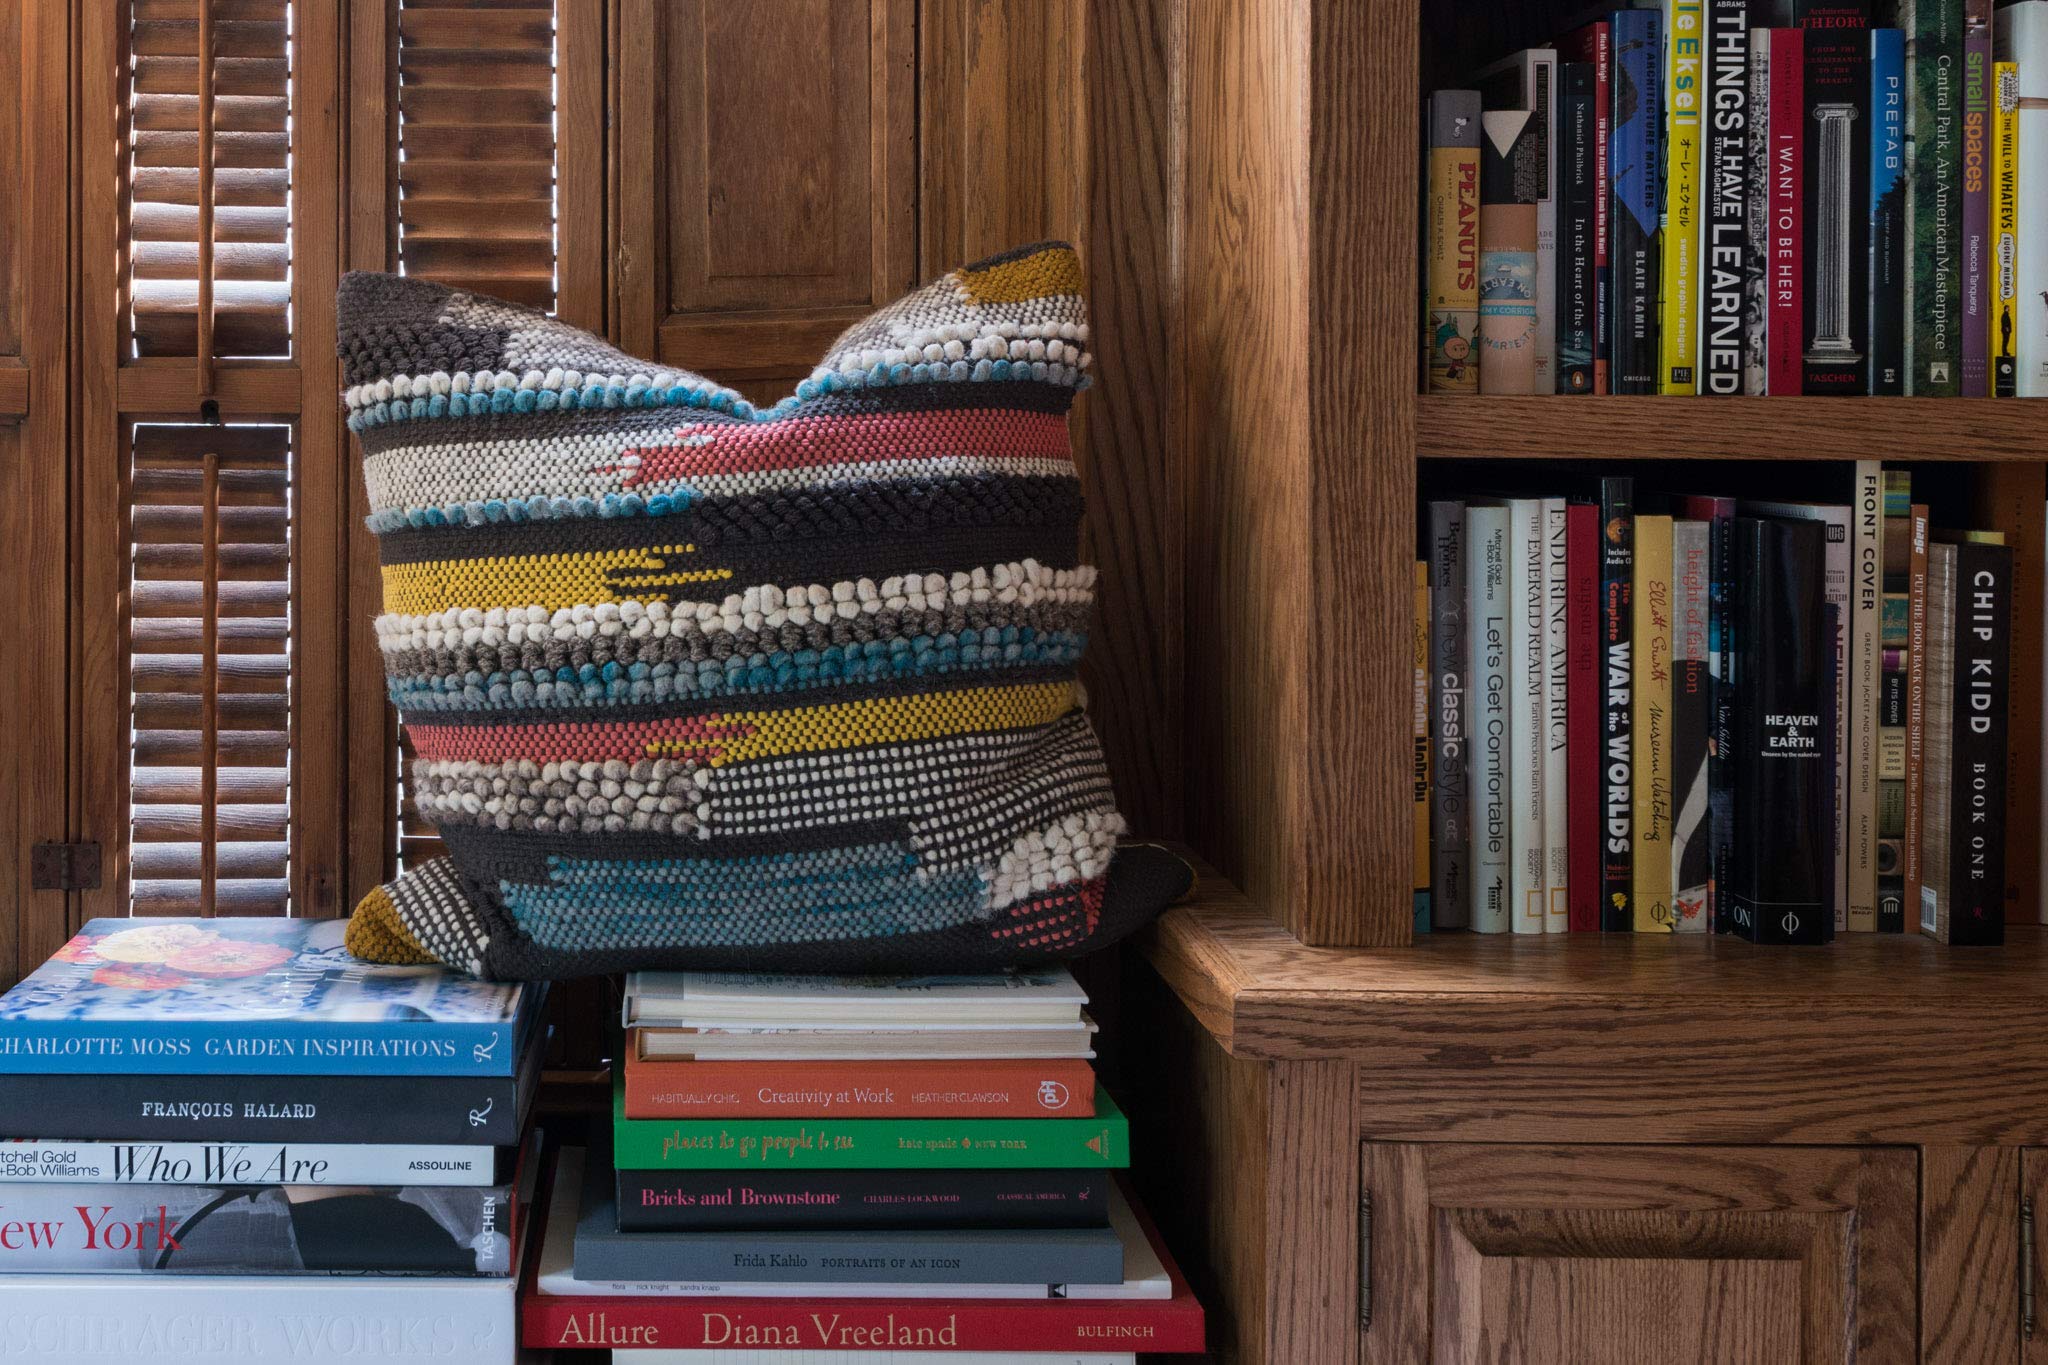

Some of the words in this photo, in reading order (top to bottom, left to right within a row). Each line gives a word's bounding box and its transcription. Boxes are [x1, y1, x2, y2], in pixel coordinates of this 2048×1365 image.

[1646, 21, 1657, 41] WHY
[1801, 17, 1867, 28] THEORY
[1714, 11, 1746, 131] THINGS
[1937, 54, 1951, 109] Central
[1645, 53, 1656, 146] ARCHITECTURE
[1575, 103, 1585, 144] Nathaniel
[1885, 76, 1899, 169] PREFAB
[1936, 112, 1951, 154] Park,
[2003, 118, 2012, 131] THE
[1713, 137, 1722, 166] STEFAN
[1723, 137, 1743, 148] I
[2002, 134, 2013, 156] WILL
[1575, 147, 1585, 185] Philbrick
[1644, 151, 1655, 208] MATTERS
[1779, 147, 1793, 199] WANT
[1936, 158, 1950, 179] An
[2003, 160, 2011, 168] TO
[1712, 168, 1721, 217] SAGMEISTER
[1721, 156, 1743, 217] HAVE
[2000, 170, 2014, 229] WHATEVS
[1457, 162, 1476, 292] PEANUTS
[1574, 218, 1586, 231] In
[1778, 207, 1793, 230] TO
[1936, 184, 1950, 253] American
[1574, 233, 1586, 253] the
[1679, 238, 1689, 277] swedish
[1778, 238, 1792, 258] BE
[1969, 235, 1980, 272] Rebecca
[2003, 236, 2011, 263] EUGENE
[1574, 256, 1586, 290] Heart
[1634, 251, 1645, 289] BLAIR
[1778, 266, 1792, 307] HER!
[2003, 266, 2011, 297] MIRMAN
[1574, 293, 1585, 304] of
[1677, 279, 1689, 316] graphic
[1709, 224, 1742, 394] LEARNED
[1932, 257, 1950, 350] Masterpiece
[1968, 274, 1979, 316] Tanqueray
[1574, 308, 1585, 327] the
[1634, 296, 1645, 339] KAMIN
[1574, 330, 1585, 350] Sea
[1677, 317, 1688, 359] designer
[1808, 374, 1857, 383] TASCHEN
[1530, 515, 1539, 534] THE
[1863, 475, 1876, 539] FRONT
[1449, 521, 1460, 566] Better
[1486, 539, 1495, 563] +Bob
[1494, 528, 1503, 562] Mitchell
[1915, 517, 1927, 555] Image
[1438, 537, 1453, 588] Homes
[1494, 564, 1503, 586] Gold
[1550, 509, 1566, 635] ENDURING
[1683, 550, 1703, 600] height
[1862, 548, 1875, 610] COVER
[1486, 564, 1495, 600] Williams
[1527, 539, 1541, 629] EMERALD
[1622, 583, 1632, 605] The
[1606, 582, 1620, 641] Complete
[1649, 580, 1667, 632] Elliott
[1687, 608, 1703, 629] of
[1973, 570, 1995, 642] CHIP
[1486, 617, 1504, 668] Let's
[1528, 634, 1541, 696] REALM
[1608, 641, 1631, 706] WAR
[1685, 631, 1703, 694] fashion
[1487, 676, 1504, 714] Get
[1550, 644, 1567, 752] AMERICA
[1862, 684, 1870, 713] JACKET
[1970, 659, 1992, 734] KIDD
[1608, 712, 1619, 732] the
[1621, 713, 1630, 725] of
[1648, 702, 1664, 774] Museum
[1765, 715, 1818, 726] HEAVEN
[1787, 727, 1798, 736] &
[1531, 732, 1540, 766] Precious
[1769, 737, 1815, 747] EARTH
[1487, 720, 1504, 853] Comfortable
[1531, 769, 1540, 787] Rain
[1608, 734, 1631, 854] WORLDS
[1861, 764, 1869, 793] DESIGN
[1972, 763, 1986, 823] BOOK
[1531, 791, 1540, 821] Forests
[1643, 777, 1672, 842] Watching
[1971, 836, 1985, 880] ONE
[0, 1038, 123, 1055] HARLOTTE
[131, 1038, 191, 1055] MOSS
[205, 1039, 295, 1056] GARDEN
[303, 1039, 456, 1057] INSPIRATIONS
[142, 1102, 233, 1120] FRANÇOIS
[244, 1103, 316, 1118] HALARD
[651, 1093, 713, 1103] HABITUALLY
[713, 1093, 740, 1103] CHIC
[758, 1088, 830, 1107] Creativity
[836, 1089, 850, 1103] at
[854, 1088, 894, 1103] Work
[911, 1092, 958, 1103] HEATHER
[959, 1092, 1009, 1103] CLAWSON
[663, 1130, 713, 1160] places
[719, 1130, 735, 1149] to
[739, 1135, 756, 1158] go
[762, 1128, 813, 1161] people
[834, 1135, 854, 1150] see
[898, 1138, 923, 1149] kate
[926, 1138, 957, 1151] spade
[975, 1140, 996, 1149] NEW
[1000, 1140, 1027, 1149] YORK
[41, 1163, 100, 1177] Williams
[110, 1145, 192, 1182] Who
[200, 1145, 252, 1182] We
[254, 1145, 328, 1183] Are
[408, 1161, 472, 1171] ASSOULINE
[641, 1188, 696, 1206] Bricks
[700, 1188, 733, 1206] and
[740, 1188, 840, 1206] Brownstone
[863, 1195, 906, 1203] CHARLES
[907, 1195, 960, 1203] LOCKWOOD
[0, 1205, 64, 1250] ew
[73, 1205, 187, 1250] York
[481, 1196, 496, 1262] TASCHEN
[734, 1253, 766, 1267] Frida
[770, 1253, 808, 1268] Kahlo
[821, 1258, 886, 1268] PORTRAITS
[890, 1258, 906, 1268] OF
[910, 1258, 926, 1268] AN
[931, 1258, 961, 1269] ICON
[636, 1283, 648, 1291] nick
[650, 1283, 669, 1292] knight
[680, 1283, 700, 1291] sandra
[701, 1283, 721, 1292] knapp
[274, 1314, 457, 1358] WORKS
[559, 1312, 659, 1344] Allure
[702, 1313, 800, 1344] Diana
[810, 1314, 957, 1346] Vreeland
[1078, 1326, 1154, 1337] BULFINCH
